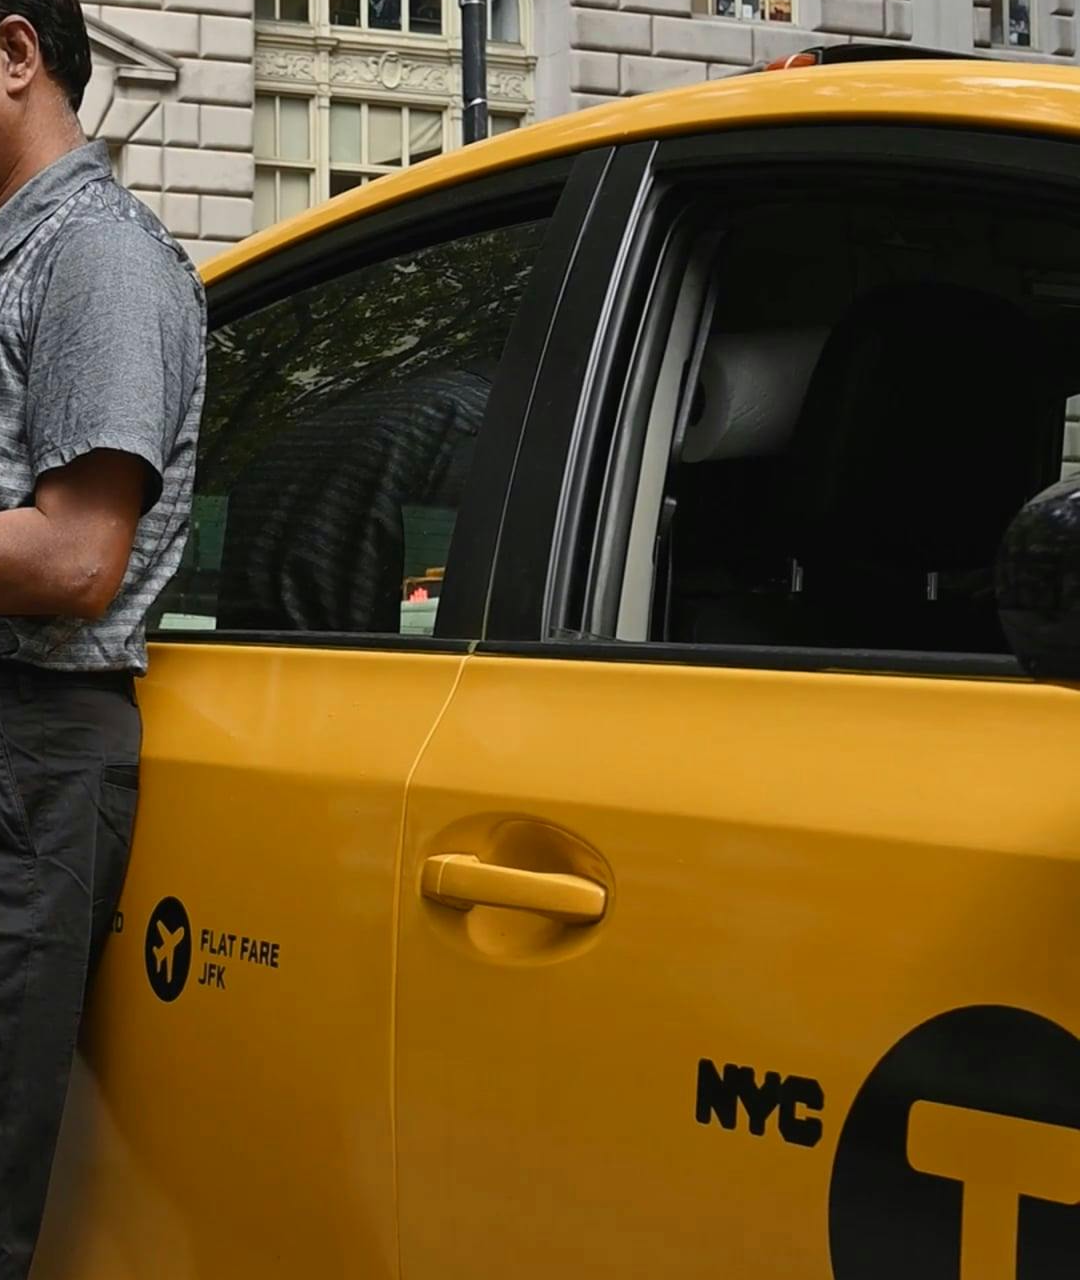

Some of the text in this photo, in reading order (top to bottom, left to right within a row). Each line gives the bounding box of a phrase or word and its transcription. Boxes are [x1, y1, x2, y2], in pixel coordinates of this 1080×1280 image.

[200, 928, 281, 969] FLAT FARE
[197, 962, 226, 990] JFK
[696, 1057, 825, 1148] NYC
